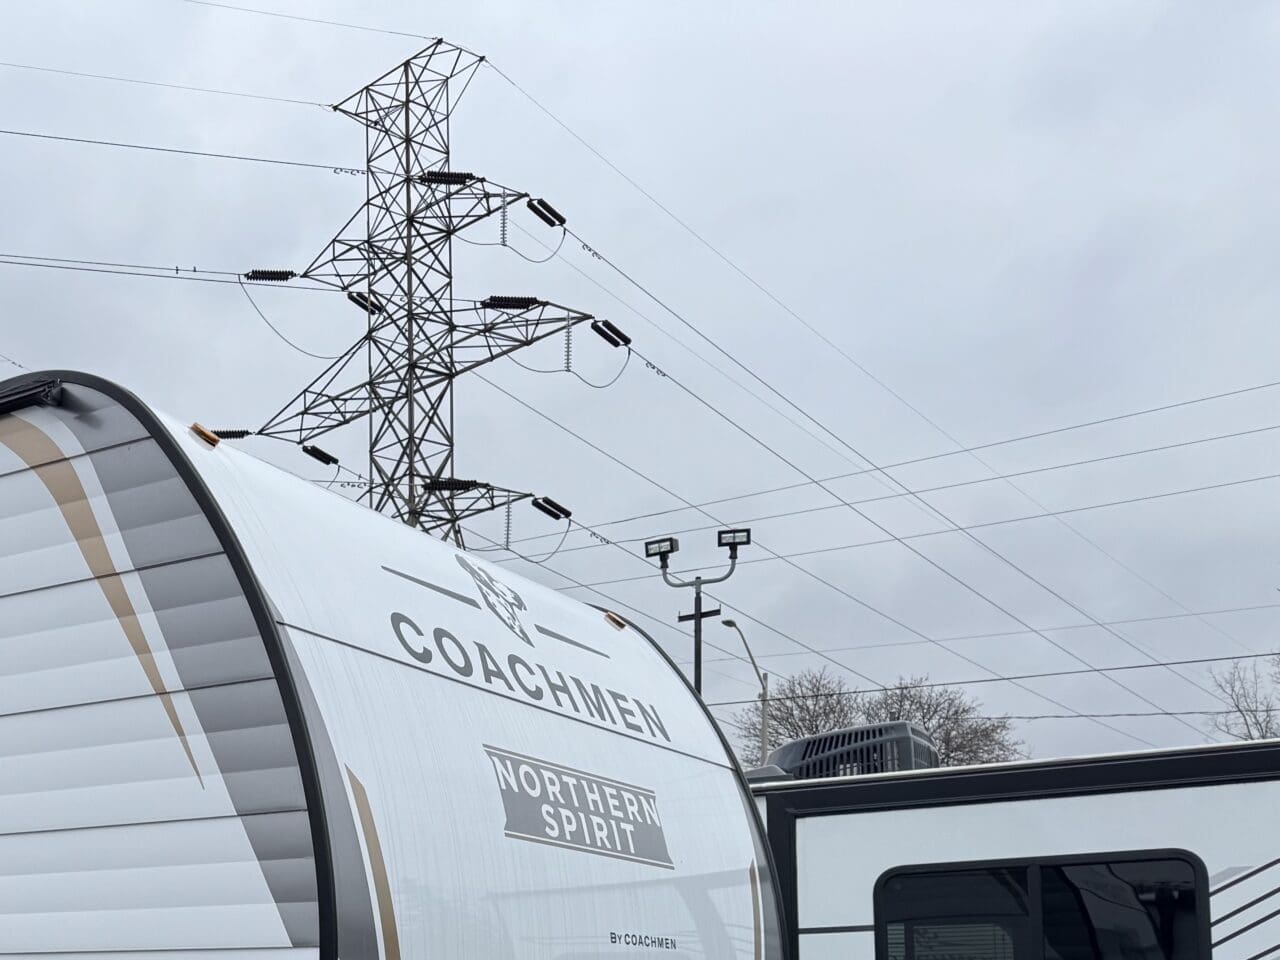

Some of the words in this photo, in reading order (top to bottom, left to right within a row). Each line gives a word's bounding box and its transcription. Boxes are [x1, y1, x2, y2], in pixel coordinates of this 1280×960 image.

[390, 612, 671, 742] COACHMEN
[492, 756, 661, 827] NORTHERN
[541, 805, 635, 854] SPIRIT
[624, 933, 677, 950] COACHMEN
